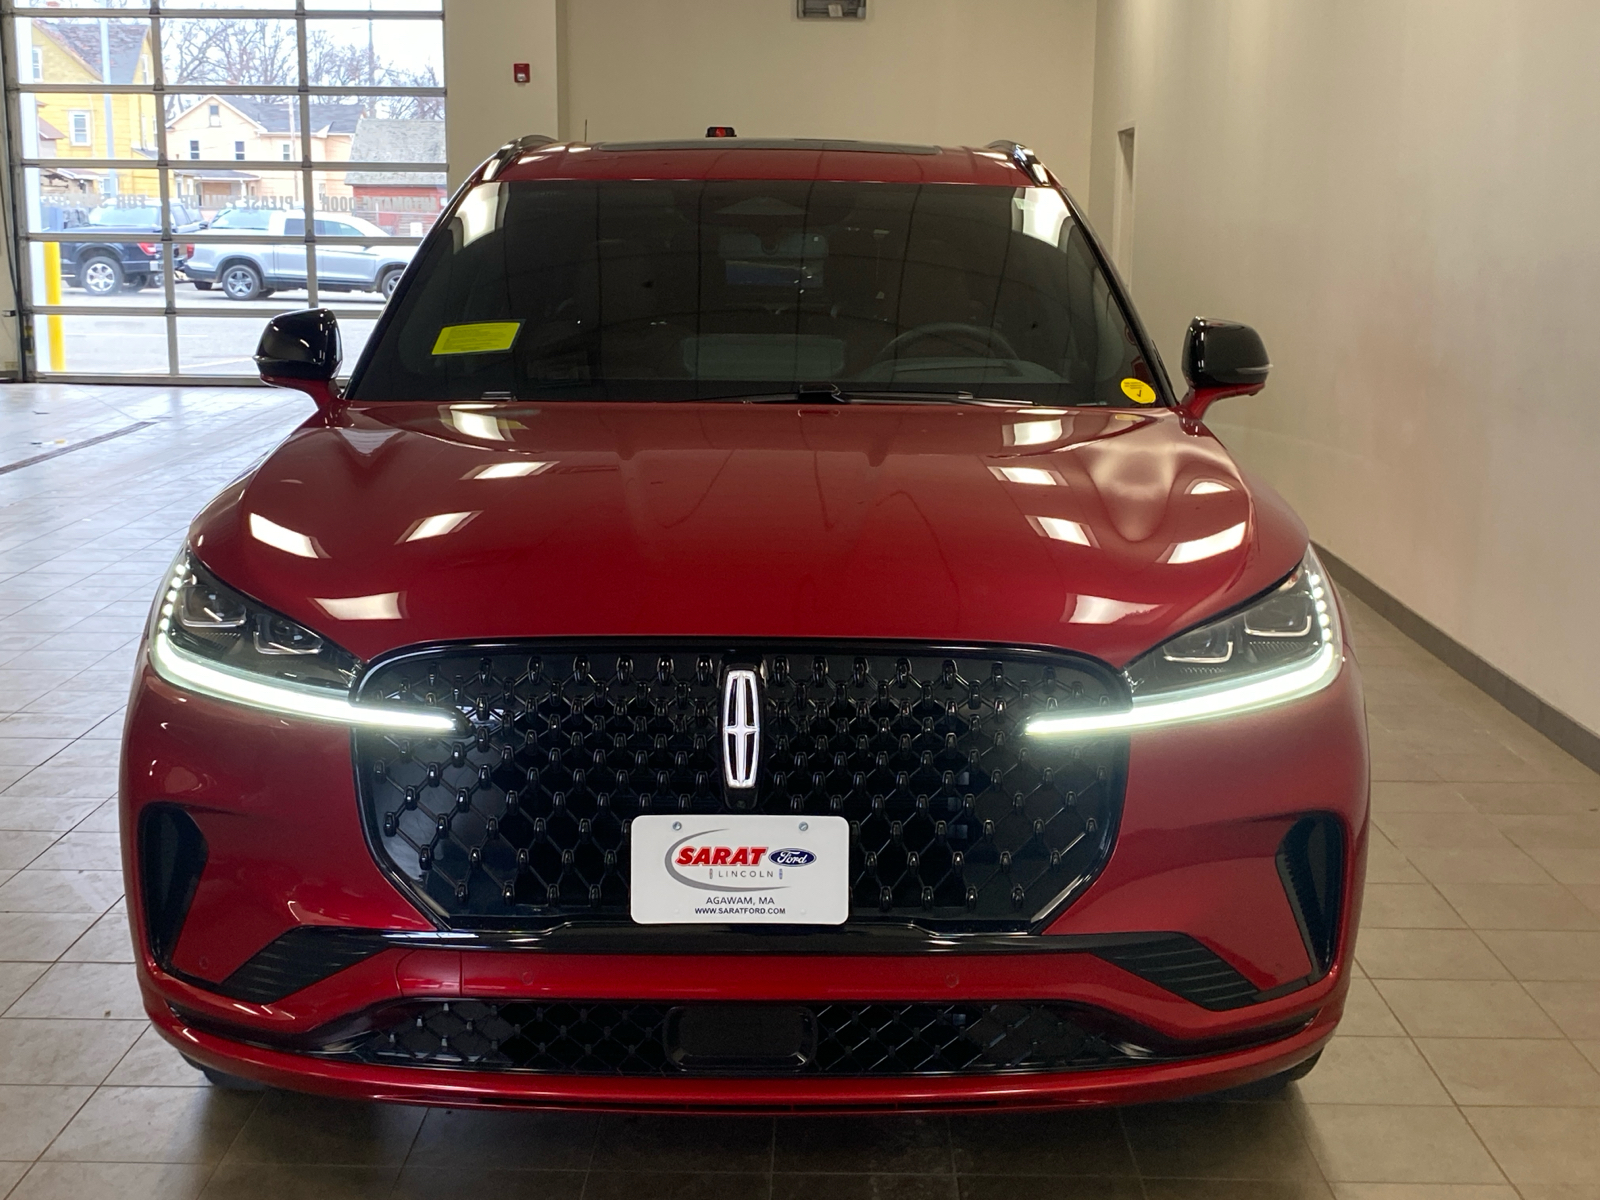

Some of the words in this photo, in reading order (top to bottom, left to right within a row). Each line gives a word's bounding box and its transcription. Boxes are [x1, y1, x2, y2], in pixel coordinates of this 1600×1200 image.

[676, 846, 768, 866] SARAT
[777, 850, 808, 865] Ford
[718, 870, 774, 878] LINCOLN
[705, 896, 756, 905] AGAWAM,
[758, 896, 775, 905] MA
[694, 907, 786, 915] WWW.SARATFORD.COM
